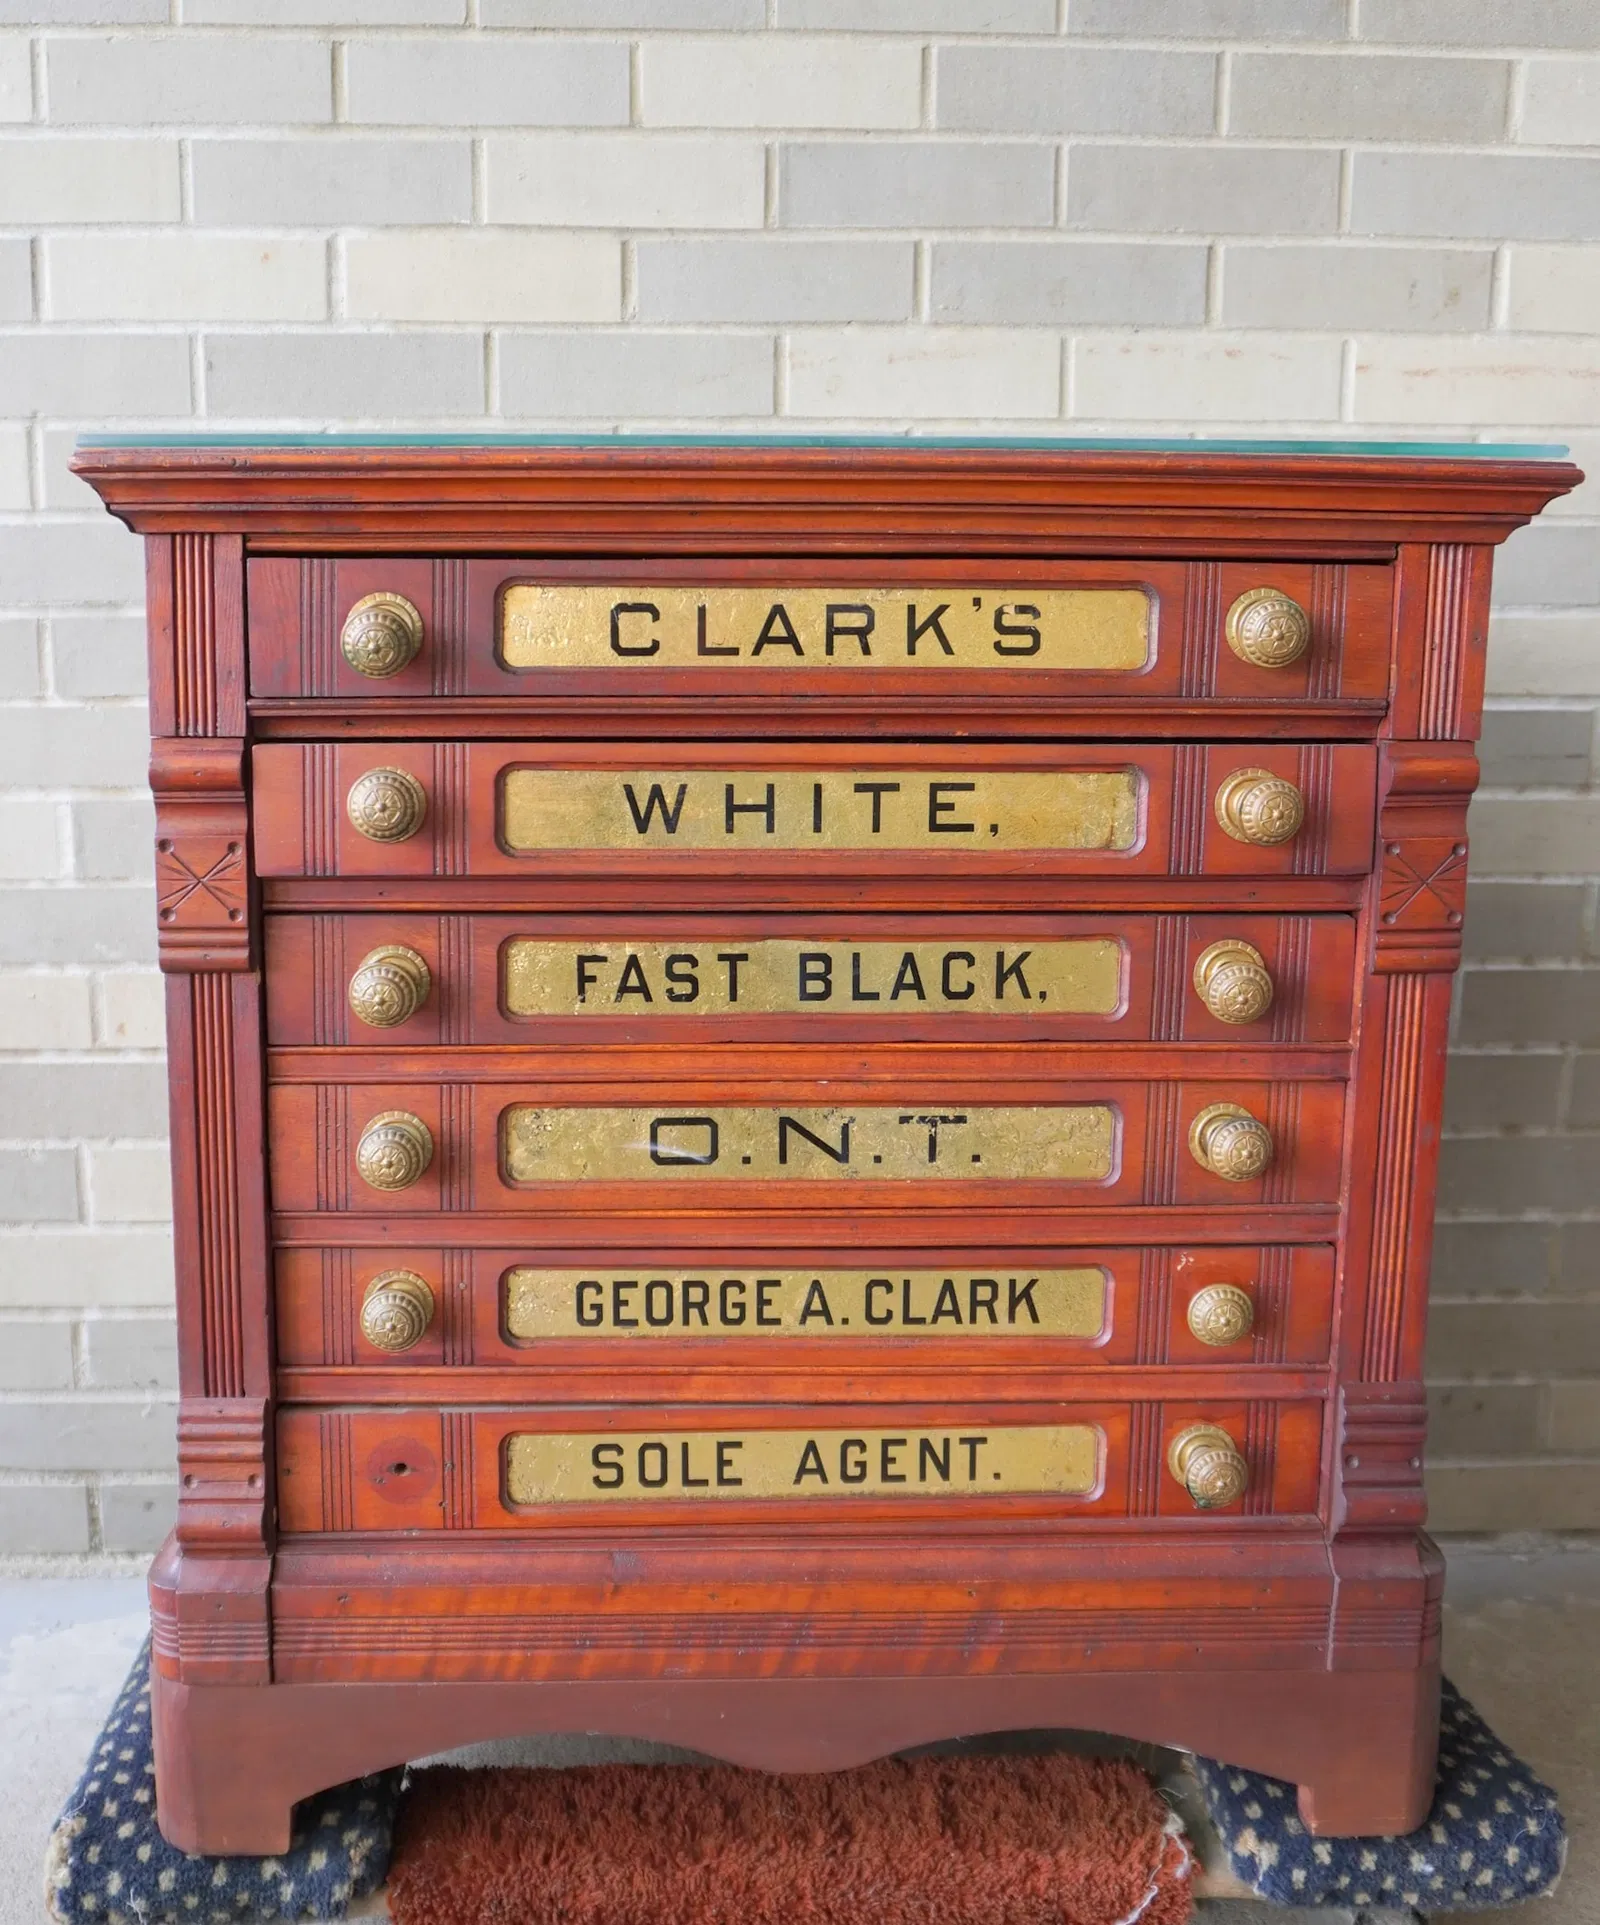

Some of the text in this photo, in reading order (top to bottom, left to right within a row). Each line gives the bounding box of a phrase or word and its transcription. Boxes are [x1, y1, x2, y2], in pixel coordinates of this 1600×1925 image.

[610, 597, 1042, 657] CLARK'S
[622, 782, 1000, 838] WHITE,
[576, 950, 1048, 1004] FAST BLACK,
[649, 1115, 982, 1166] O.N.T.
[575, 1278, 1041, 1327] GEORGE A. CLARK
[591, 1436, 1002, 1489] SOLE AGENT.
